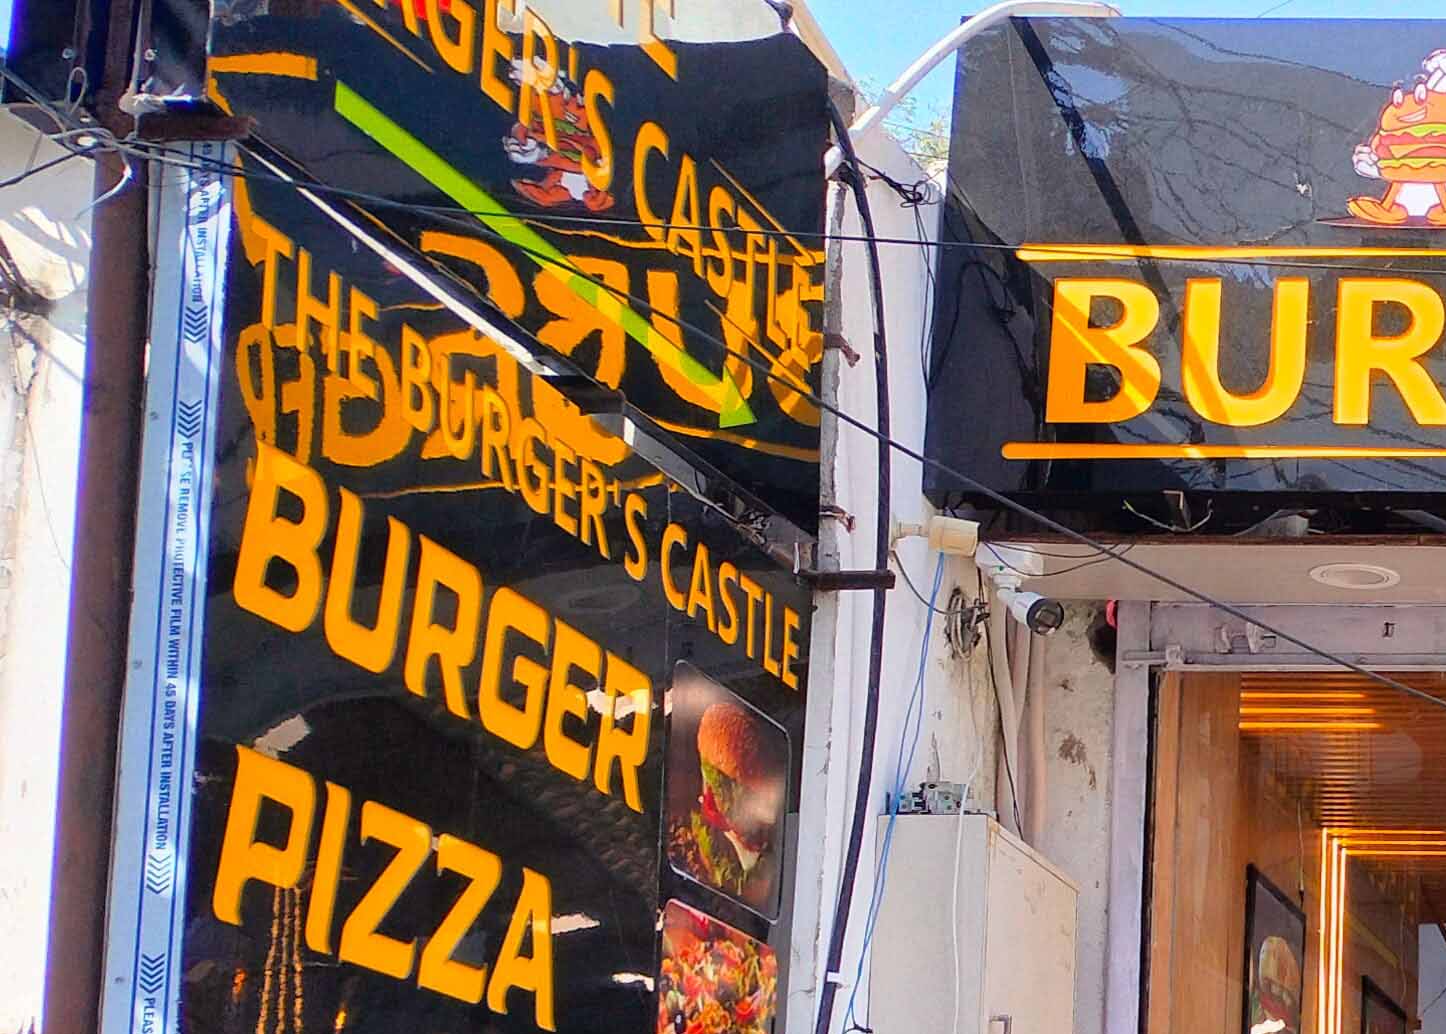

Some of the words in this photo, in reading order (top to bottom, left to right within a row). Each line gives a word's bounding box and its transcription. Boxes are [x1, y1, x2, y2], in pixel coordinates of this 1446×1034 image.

[632, 119, 812, 372] CASTLE
[252, 225, 380, 398] THE
[402, 321, 648, 583] BURGER'S
[660, 522, 800, 692] CASTLE
[169, 609, 182, 635] FILM
[233, 438, 653, 815] BURGER
[167, 639, 181, 679] WITHIN
[163, 701, 176, 729] DAYS
[165, 683, 177, 696] 45
[160, 732, 174, 768] AFTER
[155, 772, 172, 850] INSTALLATION
[212, 743, 557, 1033] PIZZA
